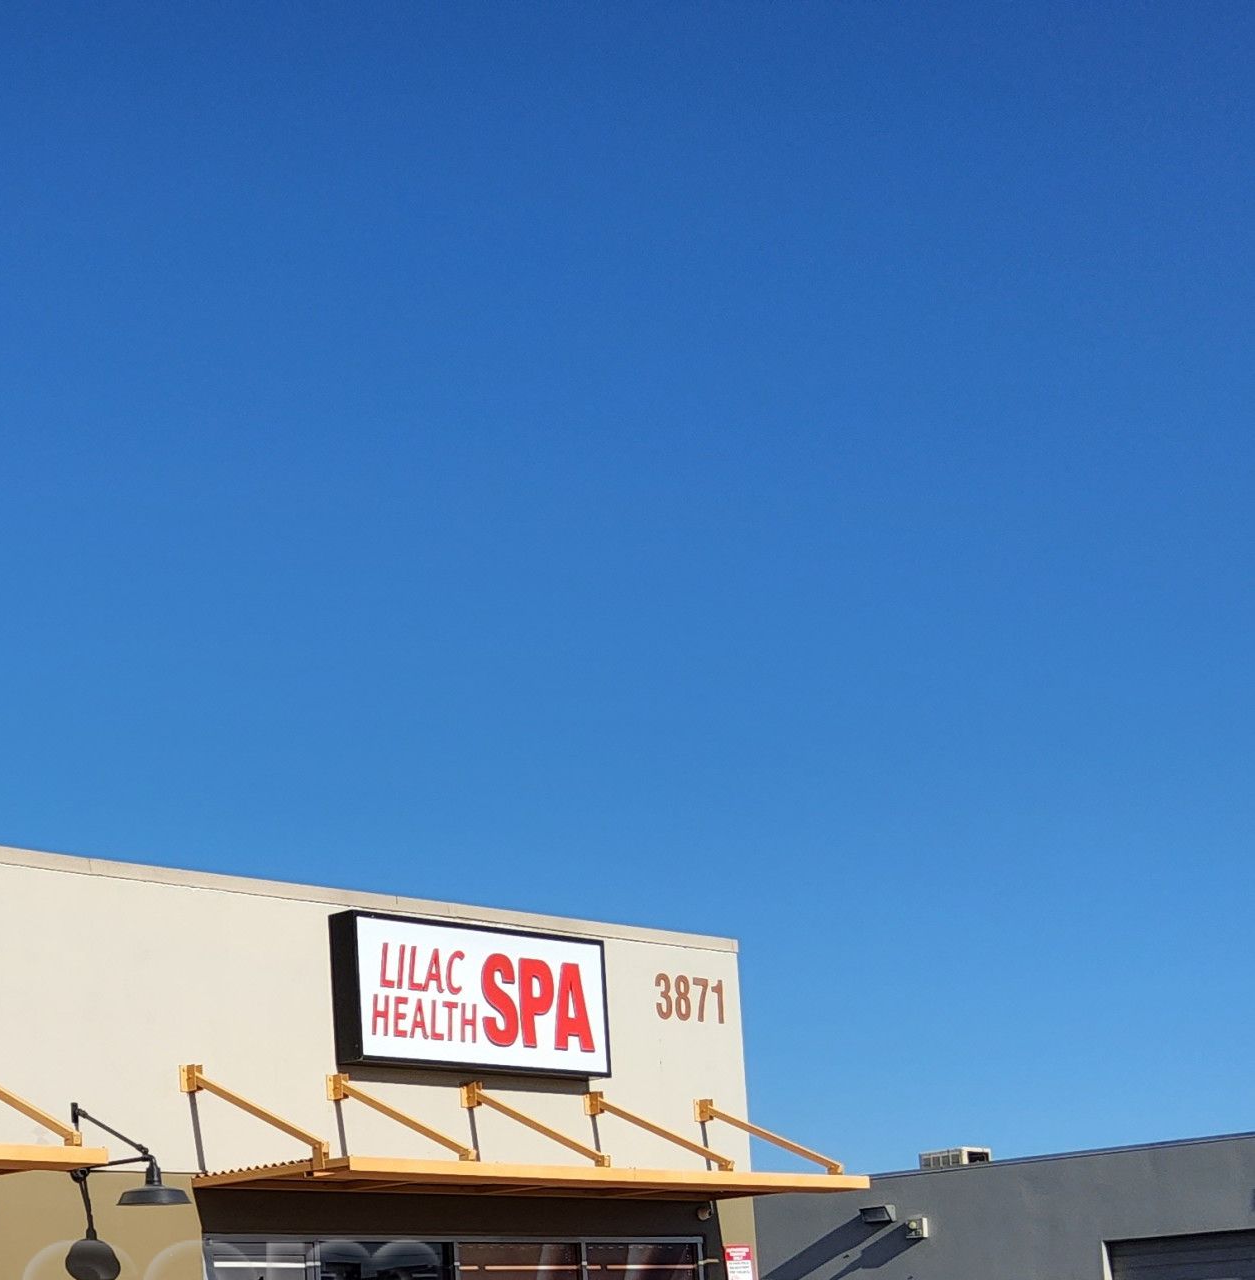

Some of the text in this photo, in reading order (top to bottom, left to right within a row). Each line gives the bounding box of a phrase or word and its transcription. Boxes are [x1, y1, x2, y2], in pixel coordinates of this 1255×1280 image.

[379, 942, 465, 995] LILAC
[371, 993, 477, 1043] HEALTH
[481, 953, 596, 1052] SPA
[654, 973, 726, 1024] 3871
